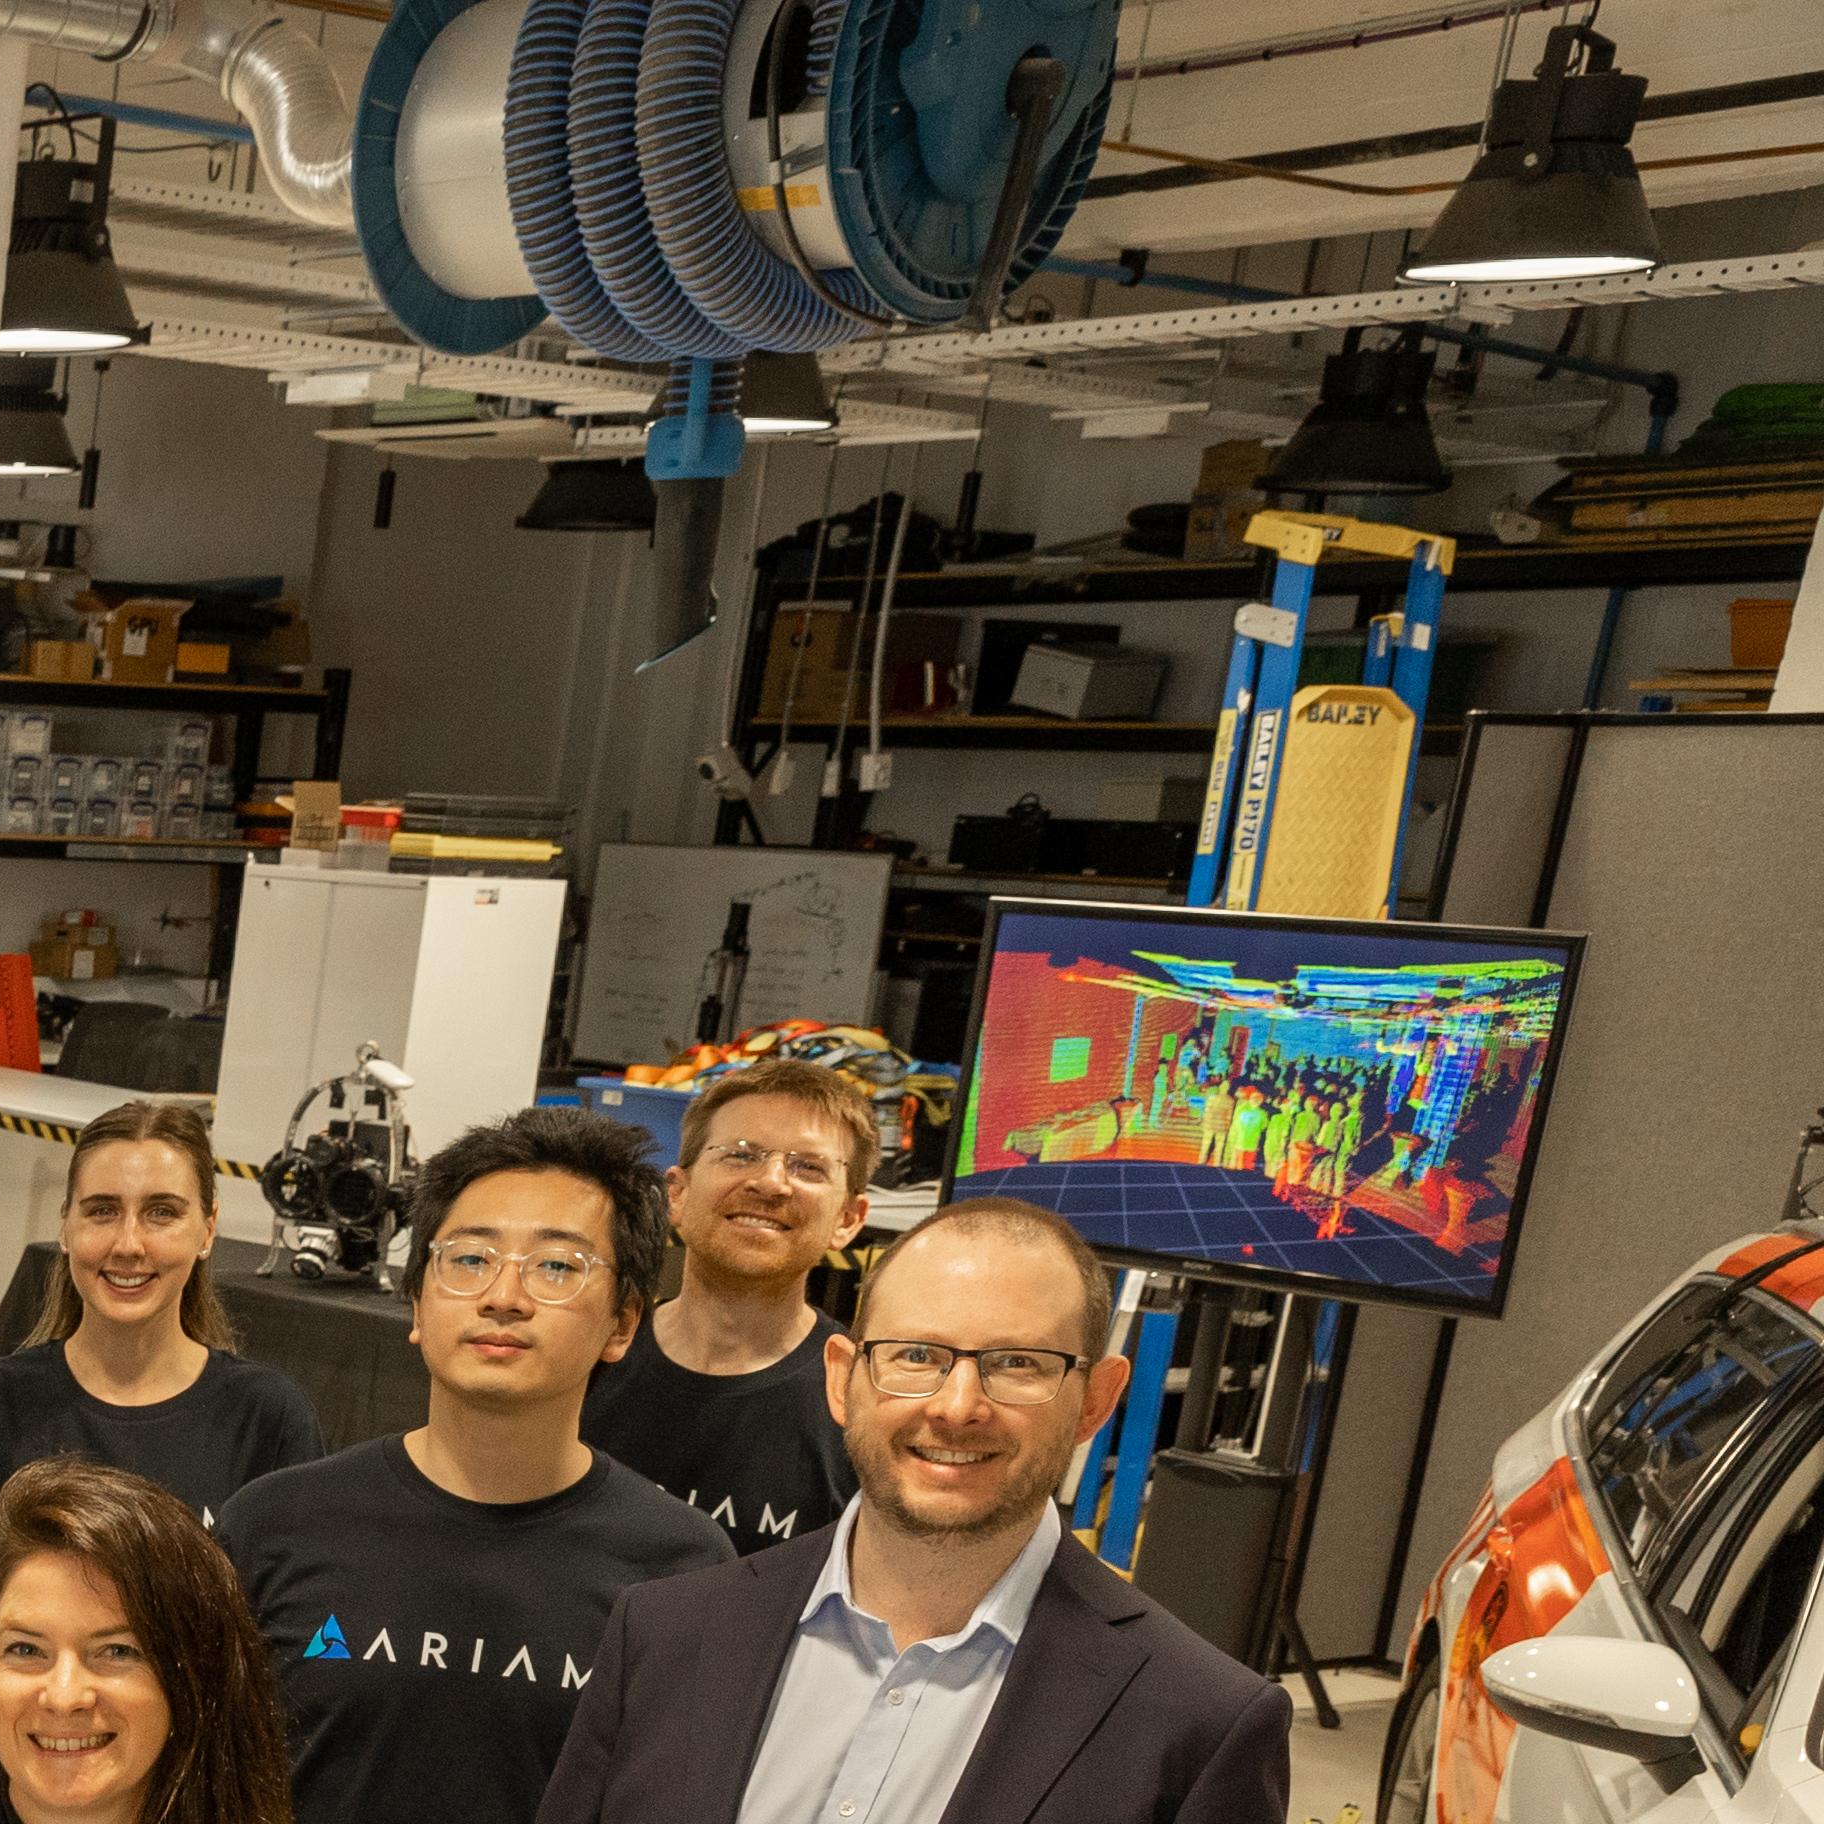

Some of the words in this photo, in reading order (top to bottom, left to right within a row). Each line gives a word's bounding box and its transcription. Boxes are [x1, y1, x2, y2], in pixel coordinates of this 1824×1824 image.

[1250, 713, 1276, 789] BAILEY
[1239, 799, 1261, 850] P170
[362, 1627, 593, 1690] ARIAM
